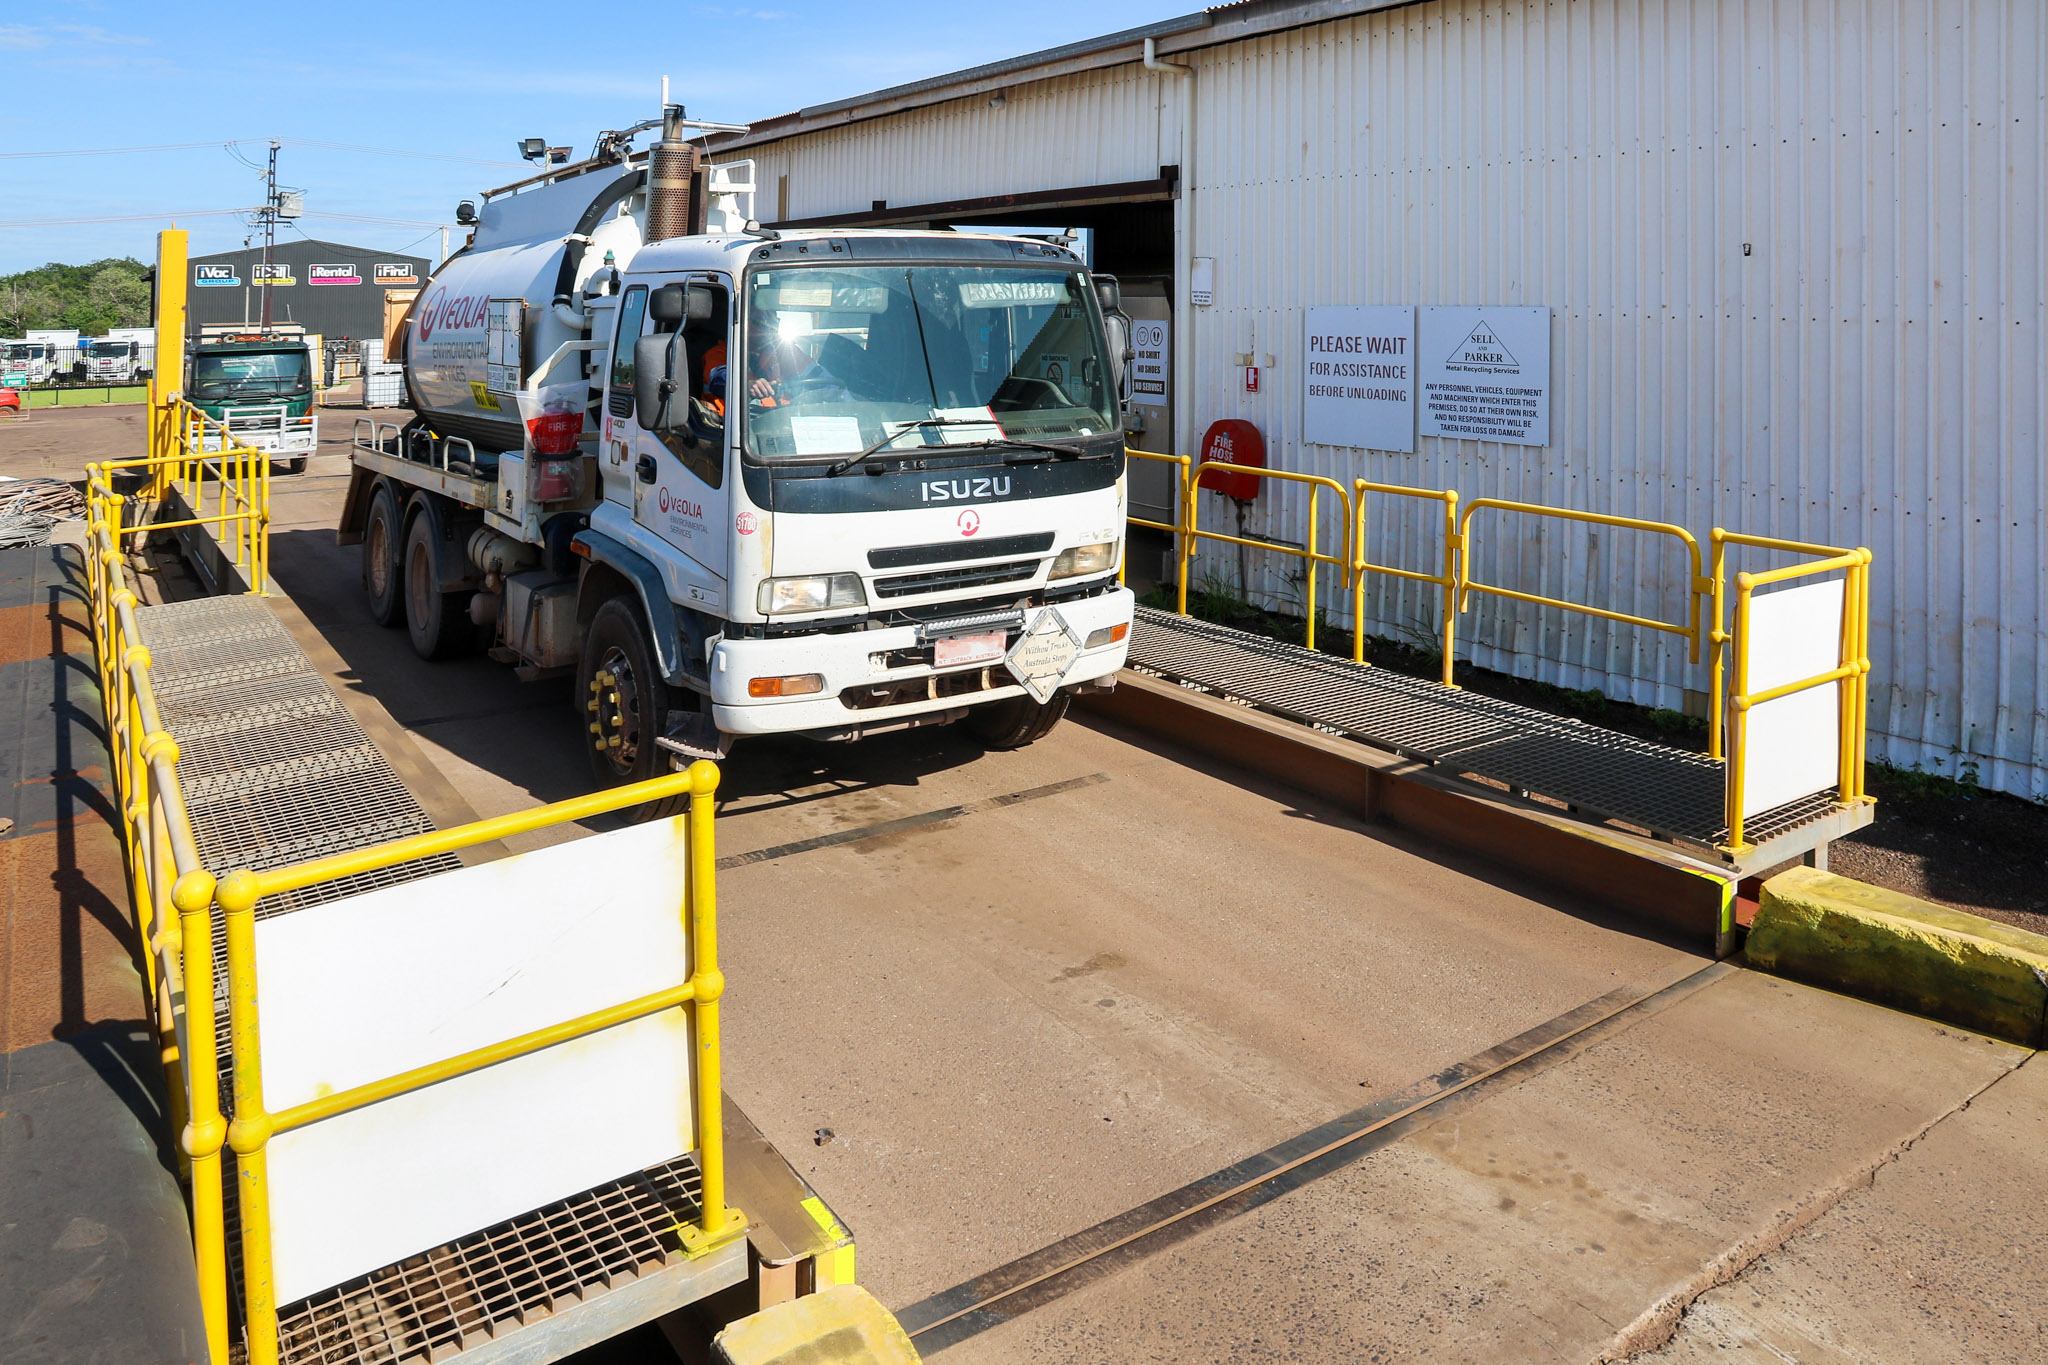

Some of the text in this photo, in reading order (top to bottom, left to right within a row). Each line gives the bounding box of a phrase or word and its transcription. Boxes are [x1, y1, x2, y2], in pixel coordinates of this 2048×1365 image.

[200, 266, 230, 278] iVac
[312, 266, 352, 277] iRental
[378, 265, 408, 276] iFind
[438, 294, 490, 330] VEOLIA
[1310, 336, 1407, 354] PLEASE WAIT
[1471, 334, 1494, 344] SELL
[1146, 351, 1160, 359] SHIRT
[1464, 352, 1503, 362] PARKER
[1138, 365, 1160, 374] NO SHOES
[1310, 362, 1407, 379] FOR ASSISTANCE
[1463, 366, 1492, 374] Recycling
[1135, 382, 1163, 392] NO SERVICE
[1310, 384, 1407, 402] BEFORE UNLOADING
[1439, 384, 1474, 393] PERSONNEL,
[1475, 386, 1504, 395] VEHICLES,
[1506, 388, 1542, 397] EQUIPMENT
[1444, 394, 1478, 403] MACHINERY
[1522, 399, 1536, 407] THIS
[1428, 403, 1458, 412] PREMISES,
[1522, 410, 1539, 418] RISK,
[1458, 415, 1506, 425] RESPONSIBILITY
[548, 422, 567, 432] FIRE
[1440, 424, 1459, 432] TAKEN
[1472, 426, 1487, 434] LOSS
[1498, 429, 1525, 438] DAMAGE
[1214, 435, 1233, 450] FIRE
[1209, 446, 1234, 463] HOSE
[922, 476, 1010, 501] ISUZU
[670, 496, 702, 519] VEOLIA
[670, 515, 708, 534] ENVIRONMENTAL
[670, 525, 692, 539] SERVICES
